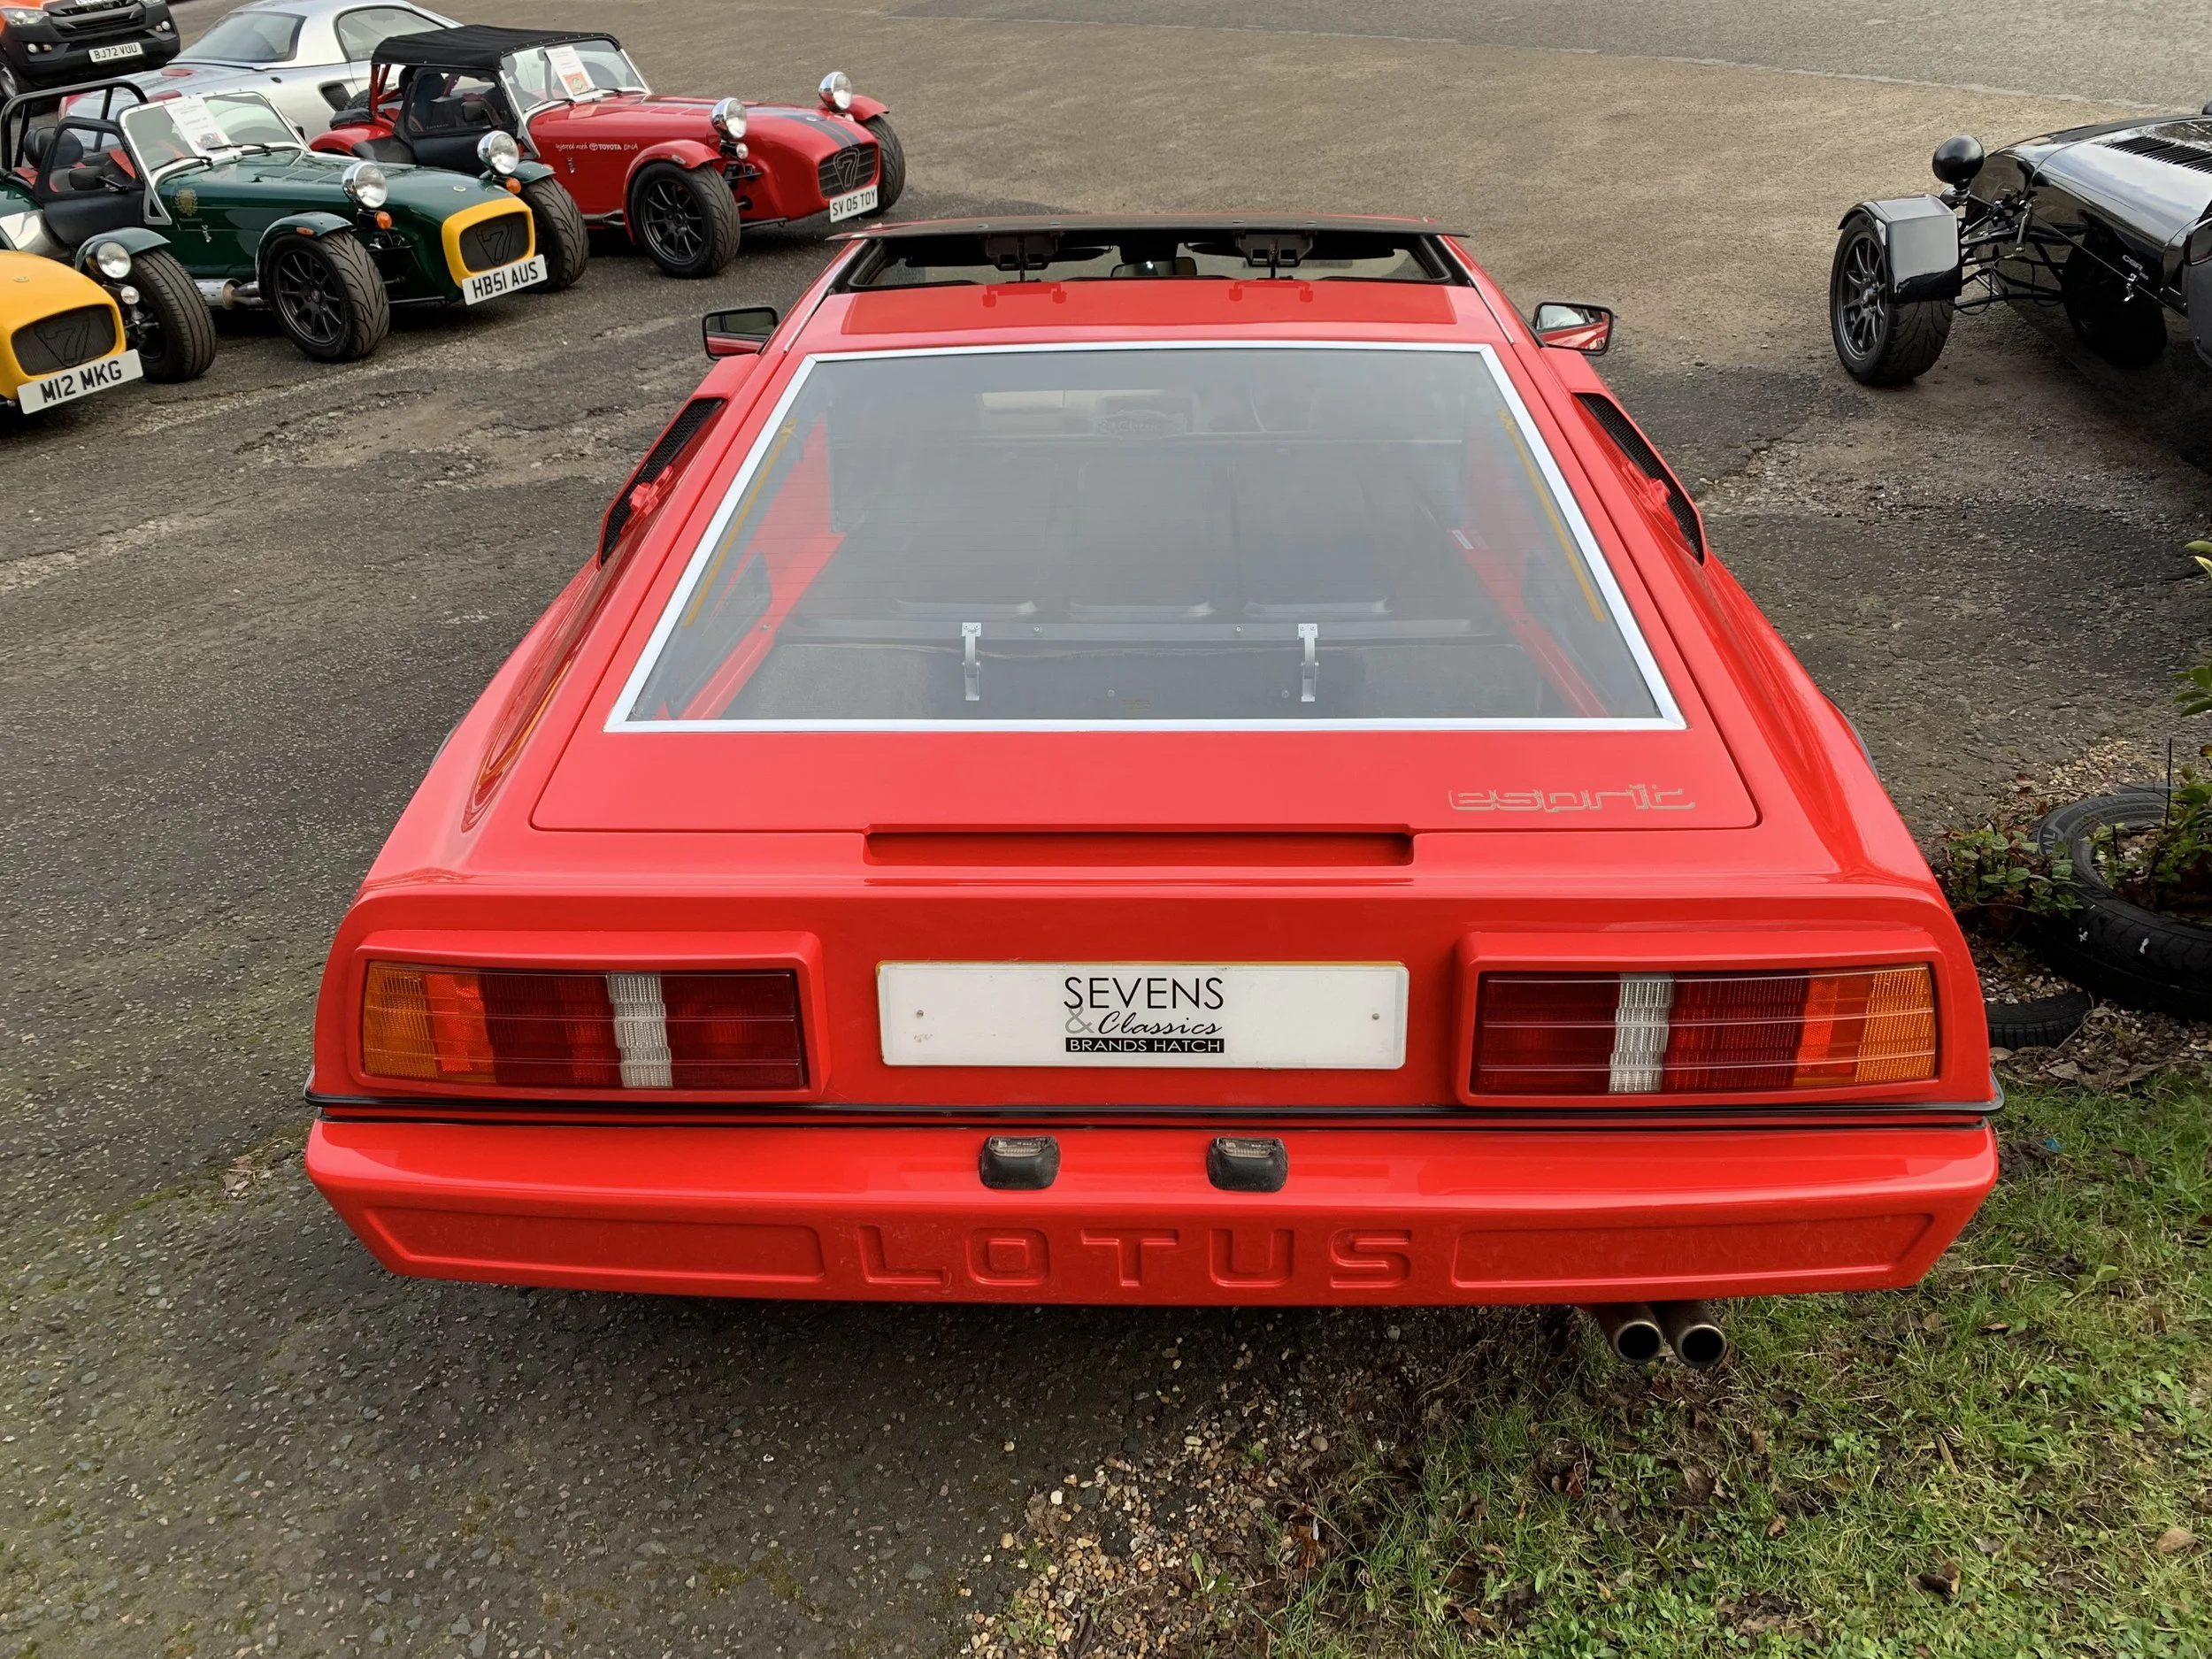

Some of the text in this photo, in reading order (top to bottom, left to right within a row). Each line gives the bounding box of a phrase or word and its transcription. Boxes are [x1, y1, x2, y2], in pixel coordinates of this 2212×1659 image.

[93, 43, 138, 59] BJ72 VUU
[832, 188, 876, 217] SV 05 TOY
[472, 261, 539, 299] HB51 AUS
[40, 359, 122, 403] M12 MKG
[1064, 977, 1224, 1010] SEVENS
[1064, 1003, 1223, 1035] & Classics
[1070, 1039, 1221, 1053] BRANDS HATCH
[856, 1224, 1413, 1288] LOTUS
